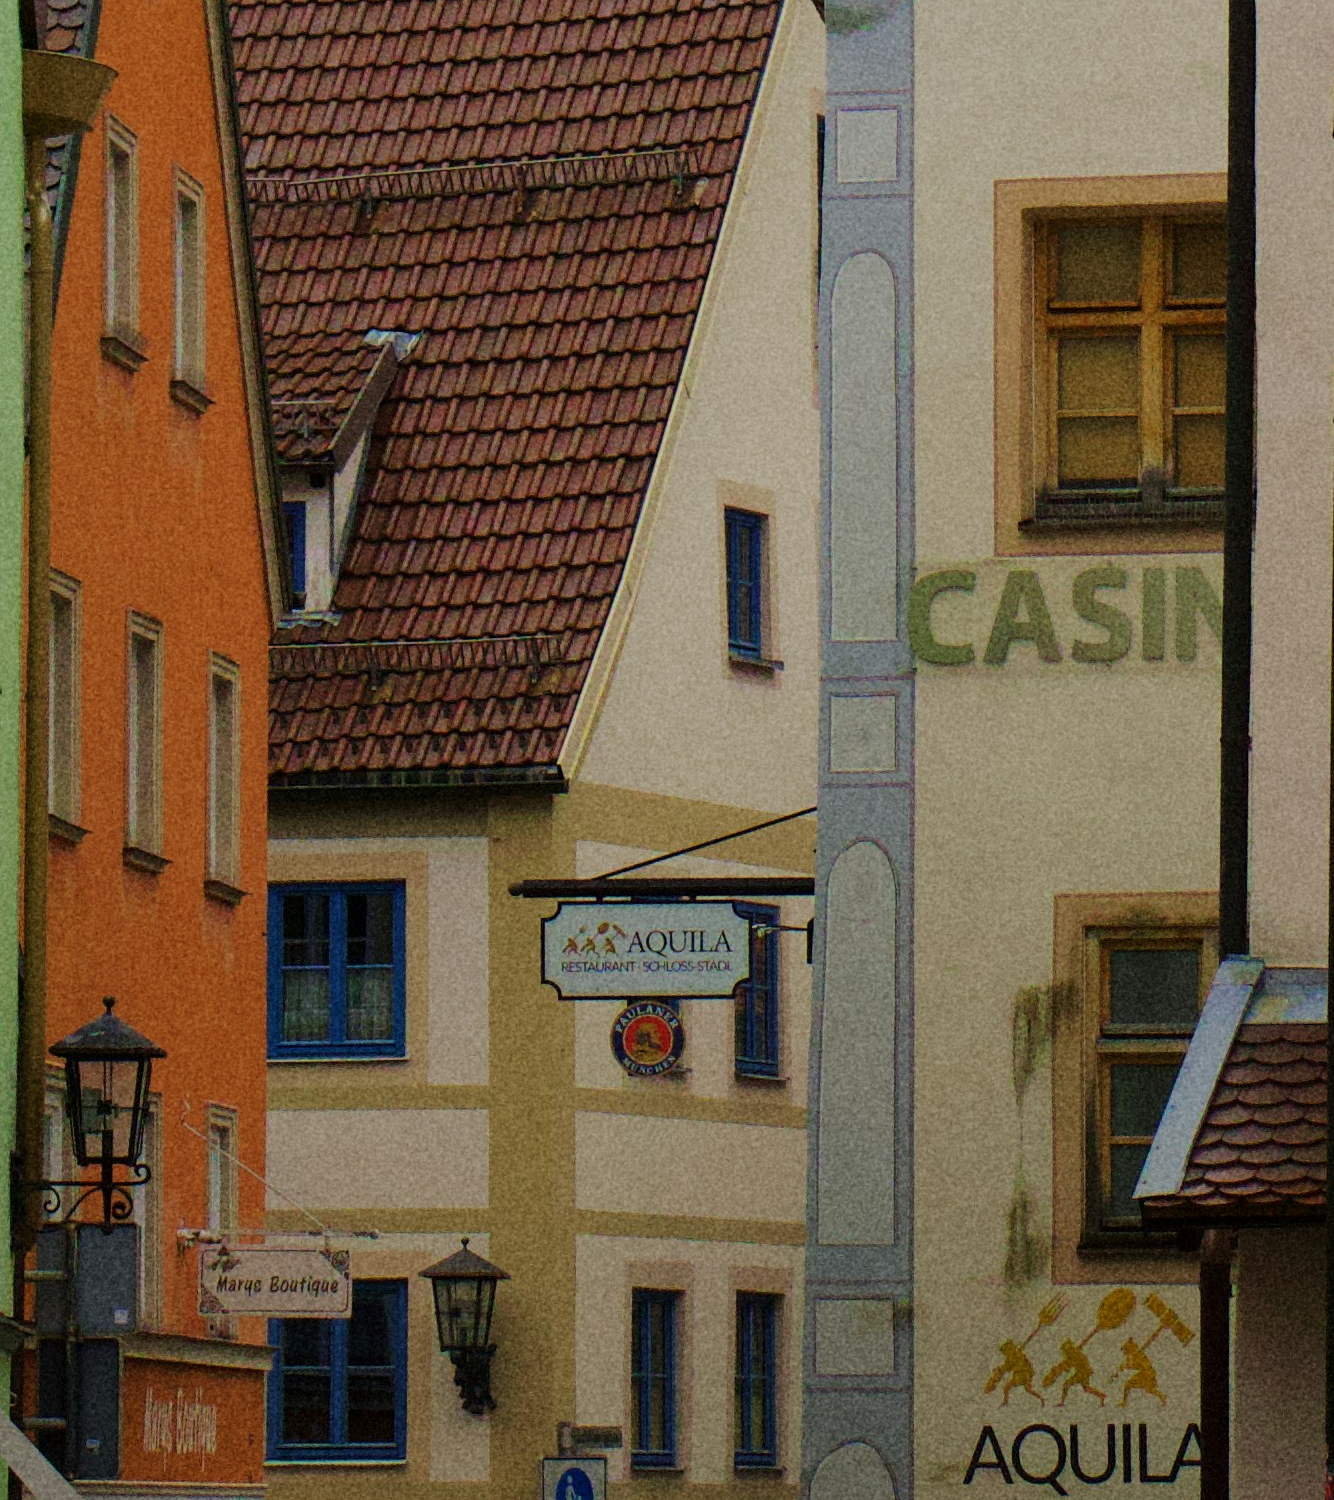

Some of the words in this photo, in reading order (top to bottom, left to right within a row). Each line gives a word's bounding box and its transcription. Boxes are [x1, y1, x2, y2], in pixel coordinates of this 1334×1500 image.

[627, 930, 733, 957] AQUILA
[561, 960, 635, 973] RESTAURANT
[642, 960, 732, 973] SCHLOSS-STADL
[615, 1004, 679, 1033] PAULANER
[216, 1276, 262, 1297] Marys
[269, 1275, 339, 1298] Boutique
[963, 1422, 1202, 1496] AQUILA
